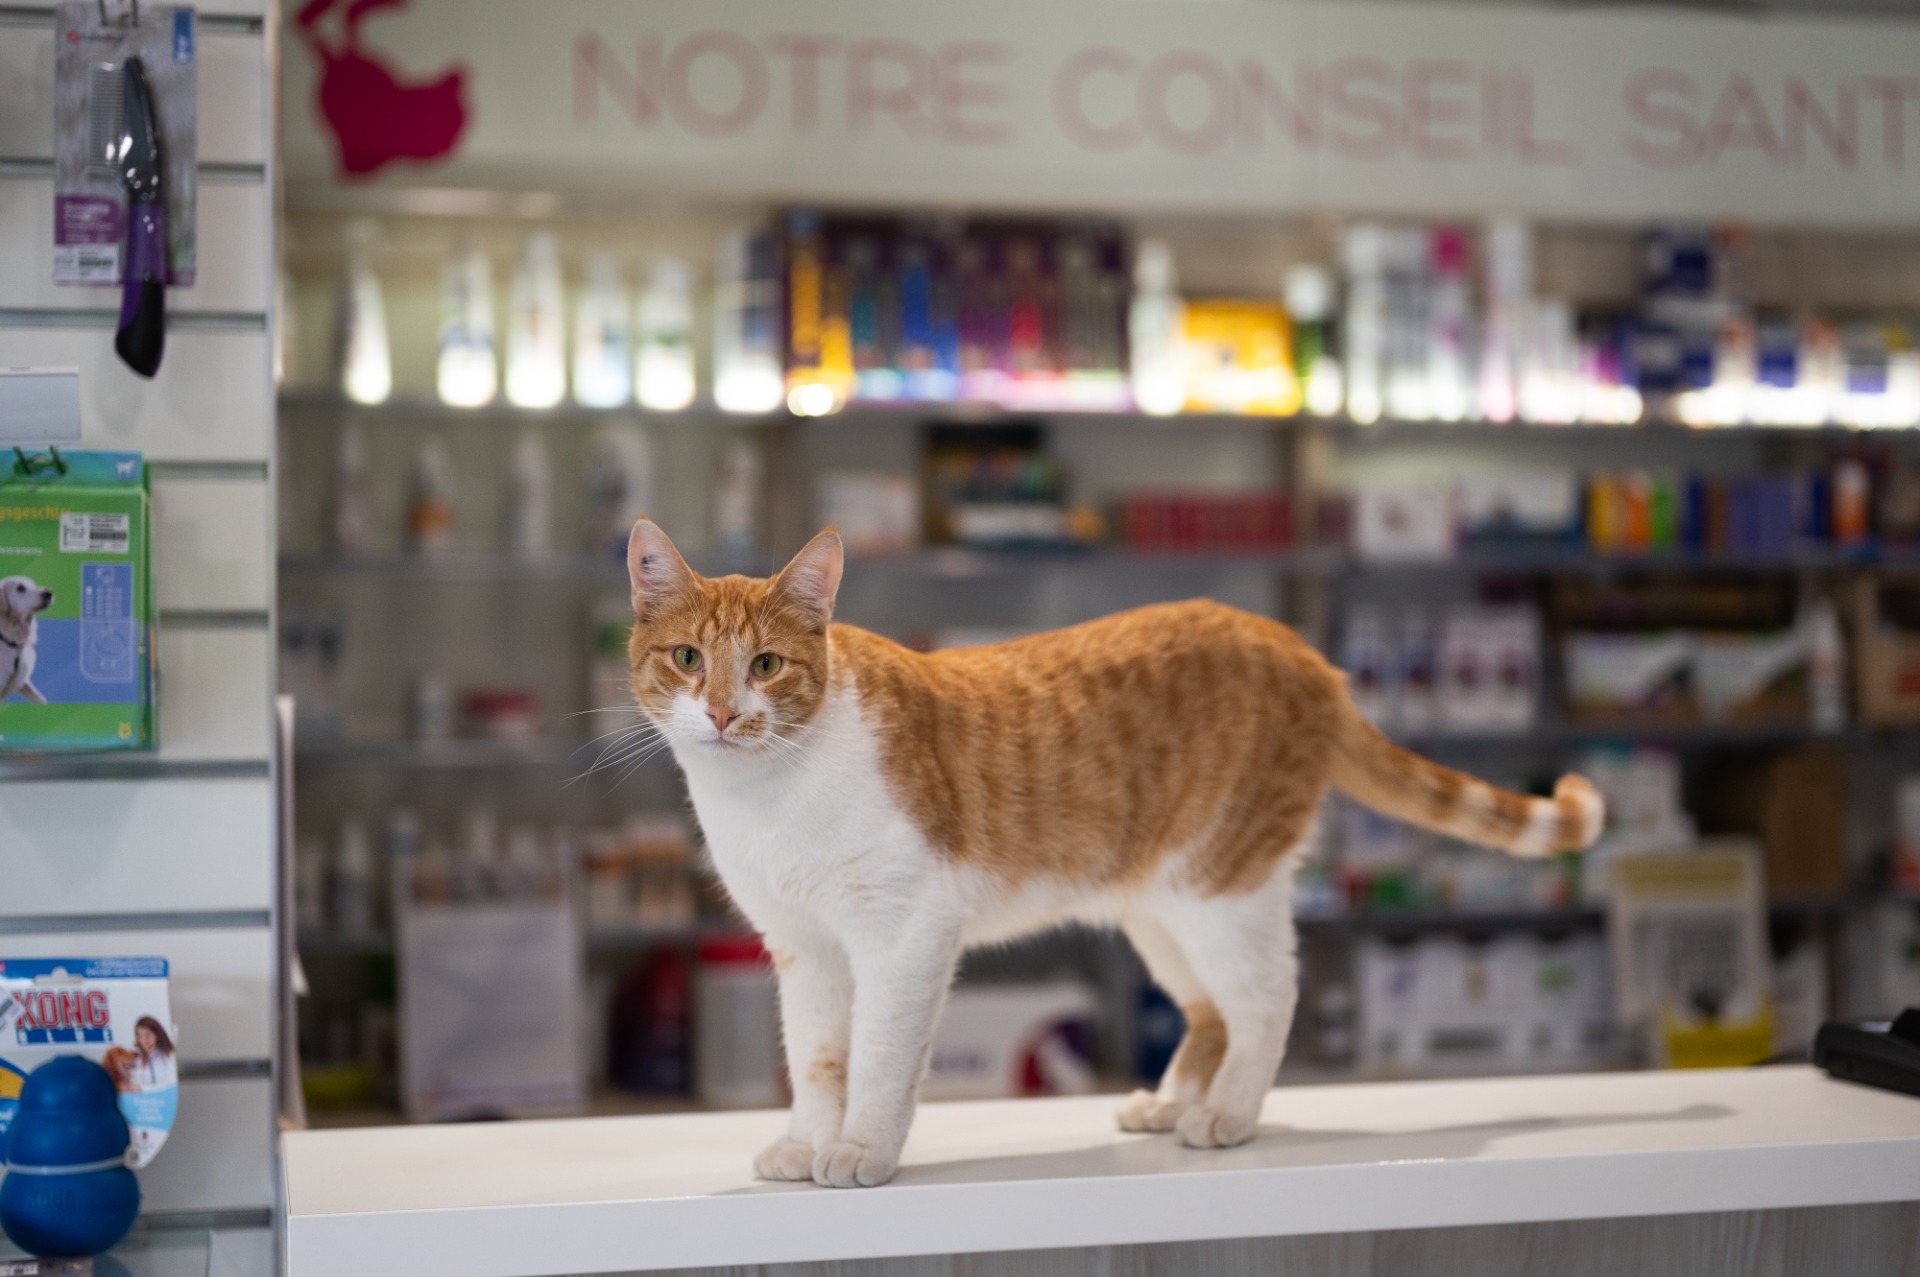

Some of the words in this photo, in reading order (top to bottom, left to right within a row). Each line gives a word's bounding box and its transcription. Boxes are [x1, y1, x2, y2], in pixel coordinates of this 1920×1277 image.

[572, 28, 1015, 147] NOTRE
[1050, 46, 1580, 167] CONSEIL
[1620, 66, 1920, 172] SANT
[12, 990, 110, 1028] KONG
